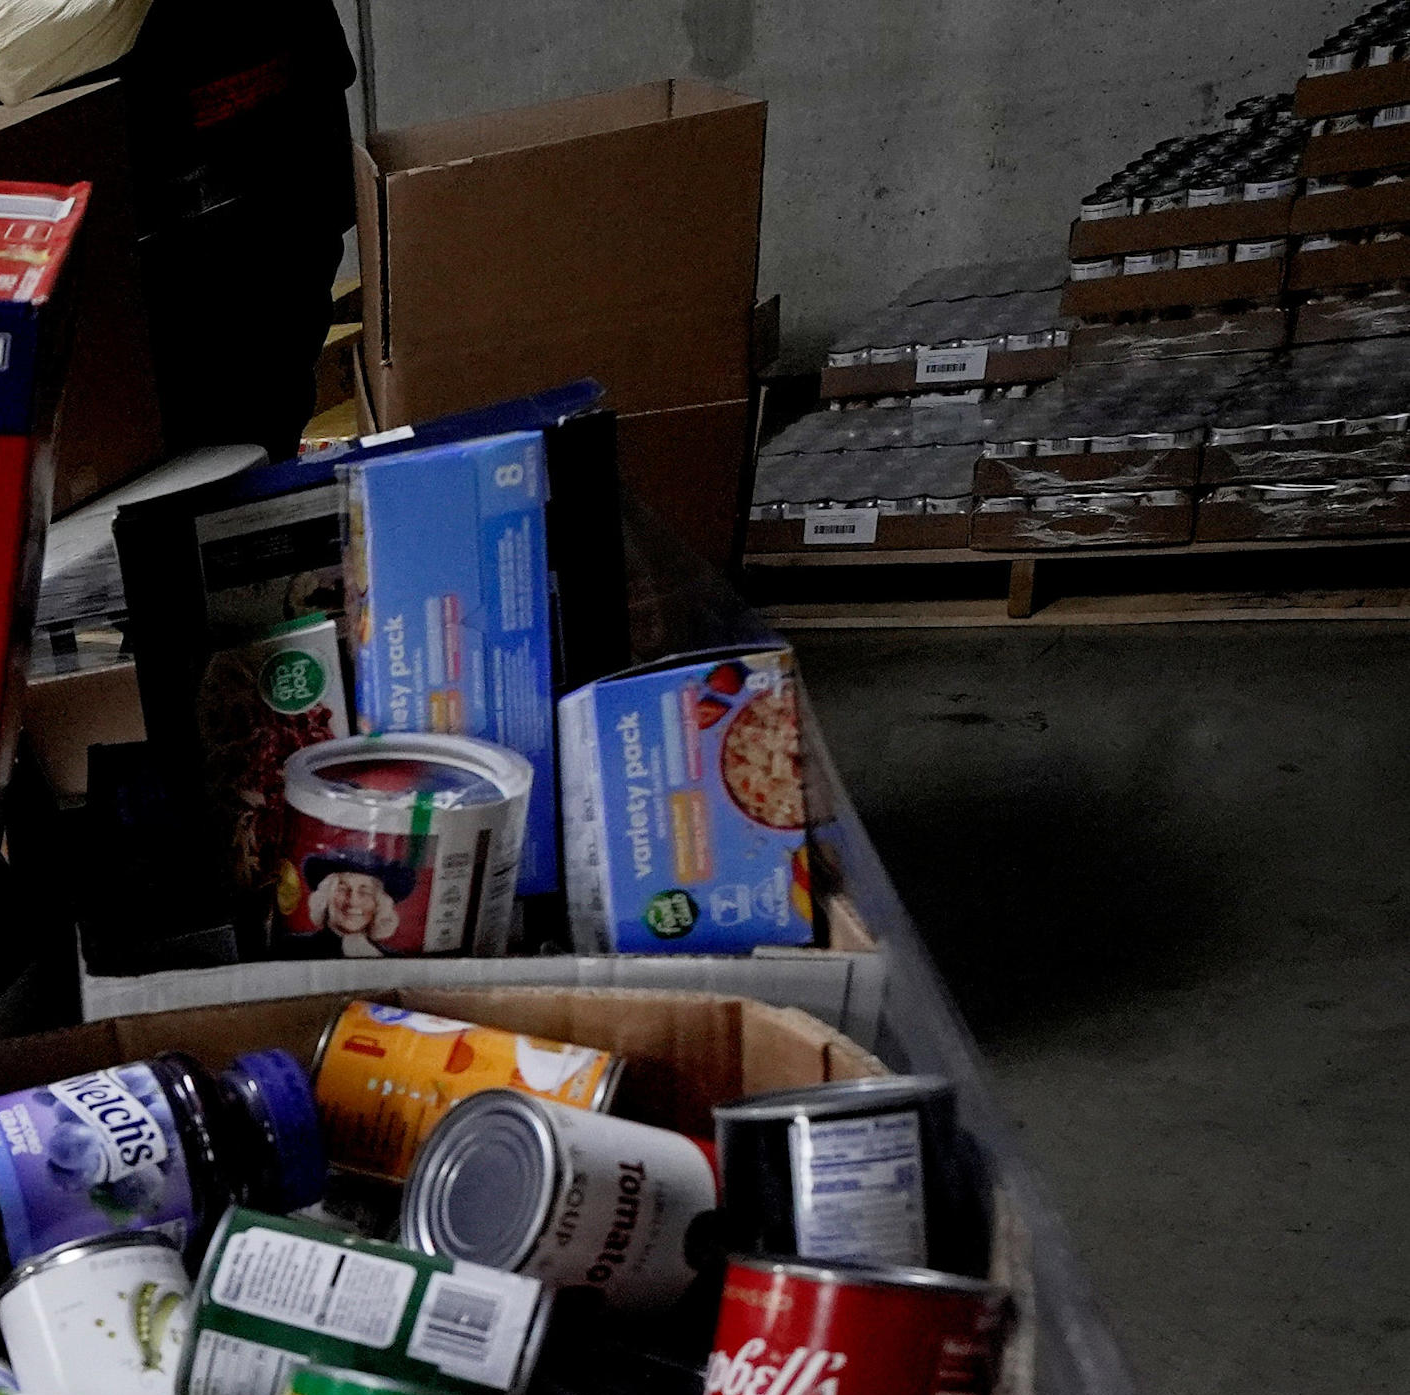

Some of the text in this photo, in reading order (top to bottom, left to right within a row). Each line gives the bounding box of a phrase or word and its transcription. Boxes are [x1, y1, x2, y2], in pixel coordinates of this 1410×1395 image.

[615, 710, 653, 880] variety pack
[61, 1075, 157, 1167] Welch's
[587, 1161, 646, 1283] Tomato
